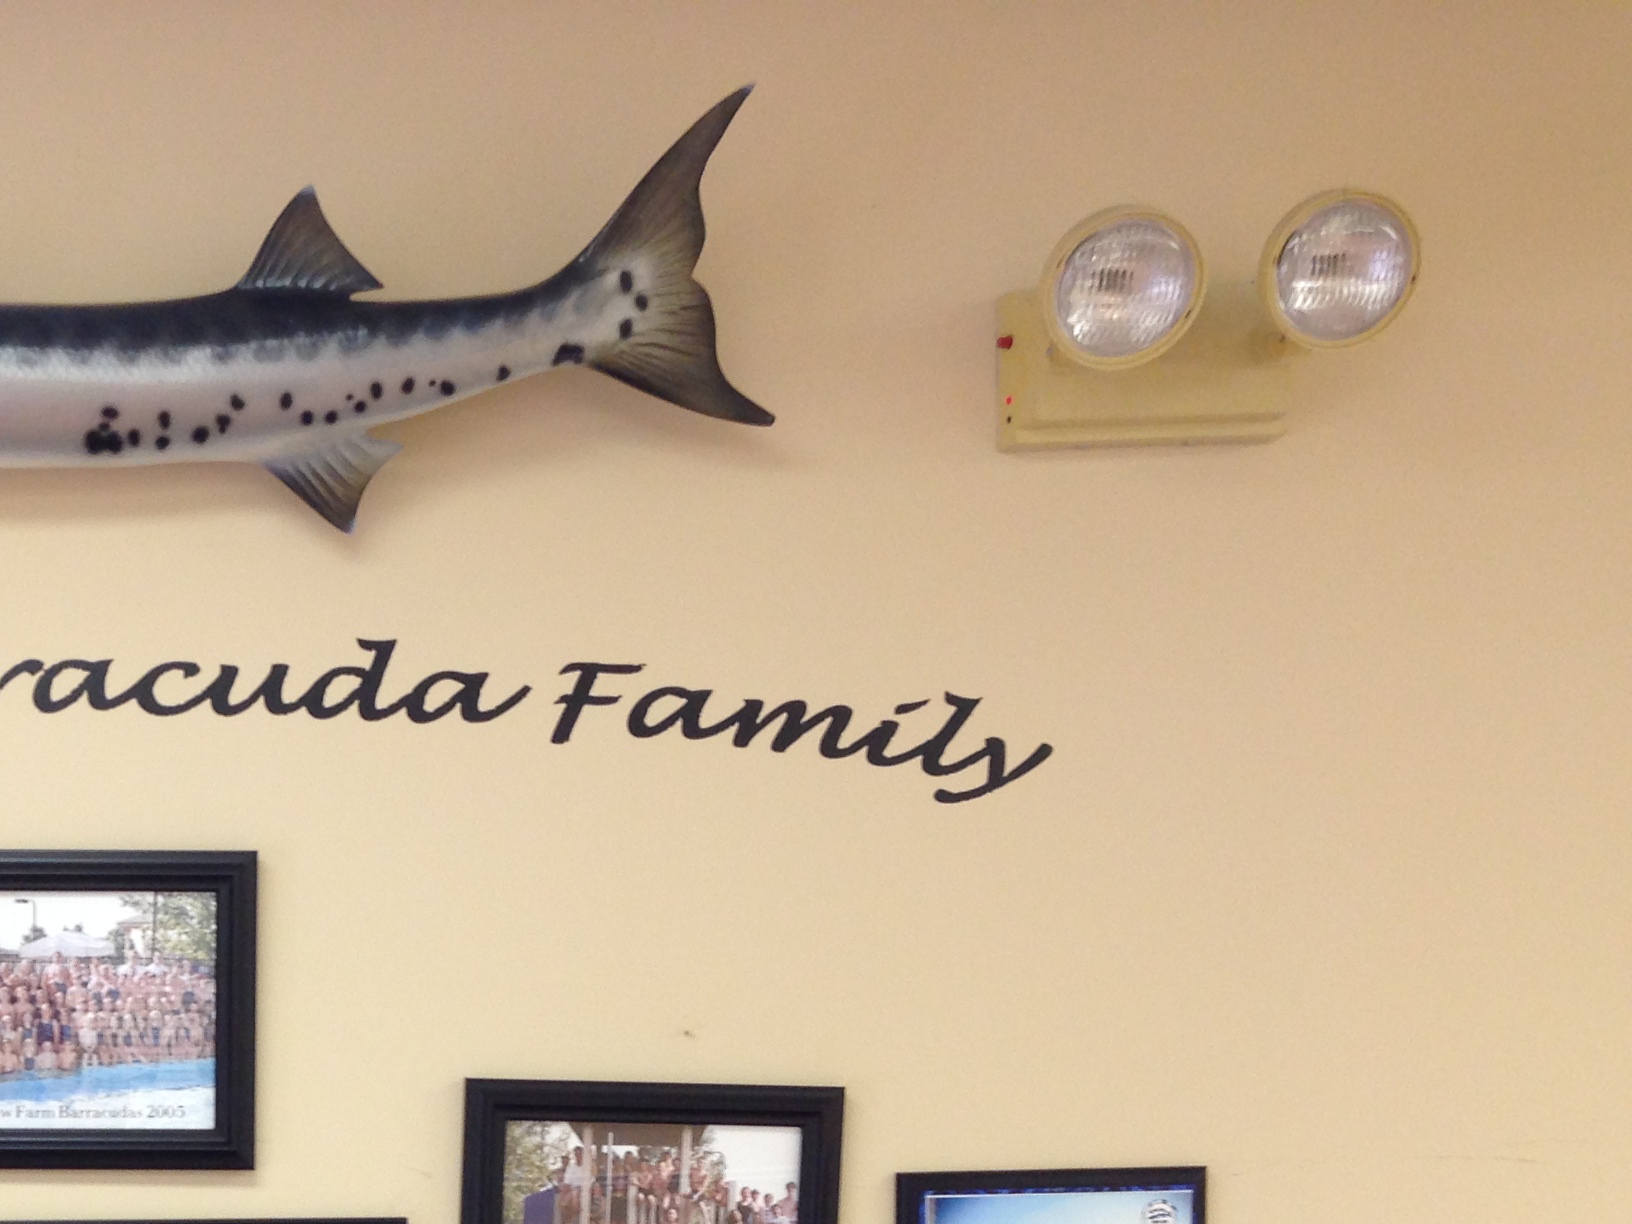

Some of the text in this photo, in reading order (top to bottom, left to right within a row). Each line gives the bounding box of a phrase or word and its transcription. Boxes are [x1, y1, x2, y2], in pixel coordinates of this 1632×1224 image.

[550, 661, 1054, 804] Family
[15, 1105, 57, 1119] Farm
[58, 1104, 143, 1119] Barracudas
[146, 1105, 187, 1119] 2005
